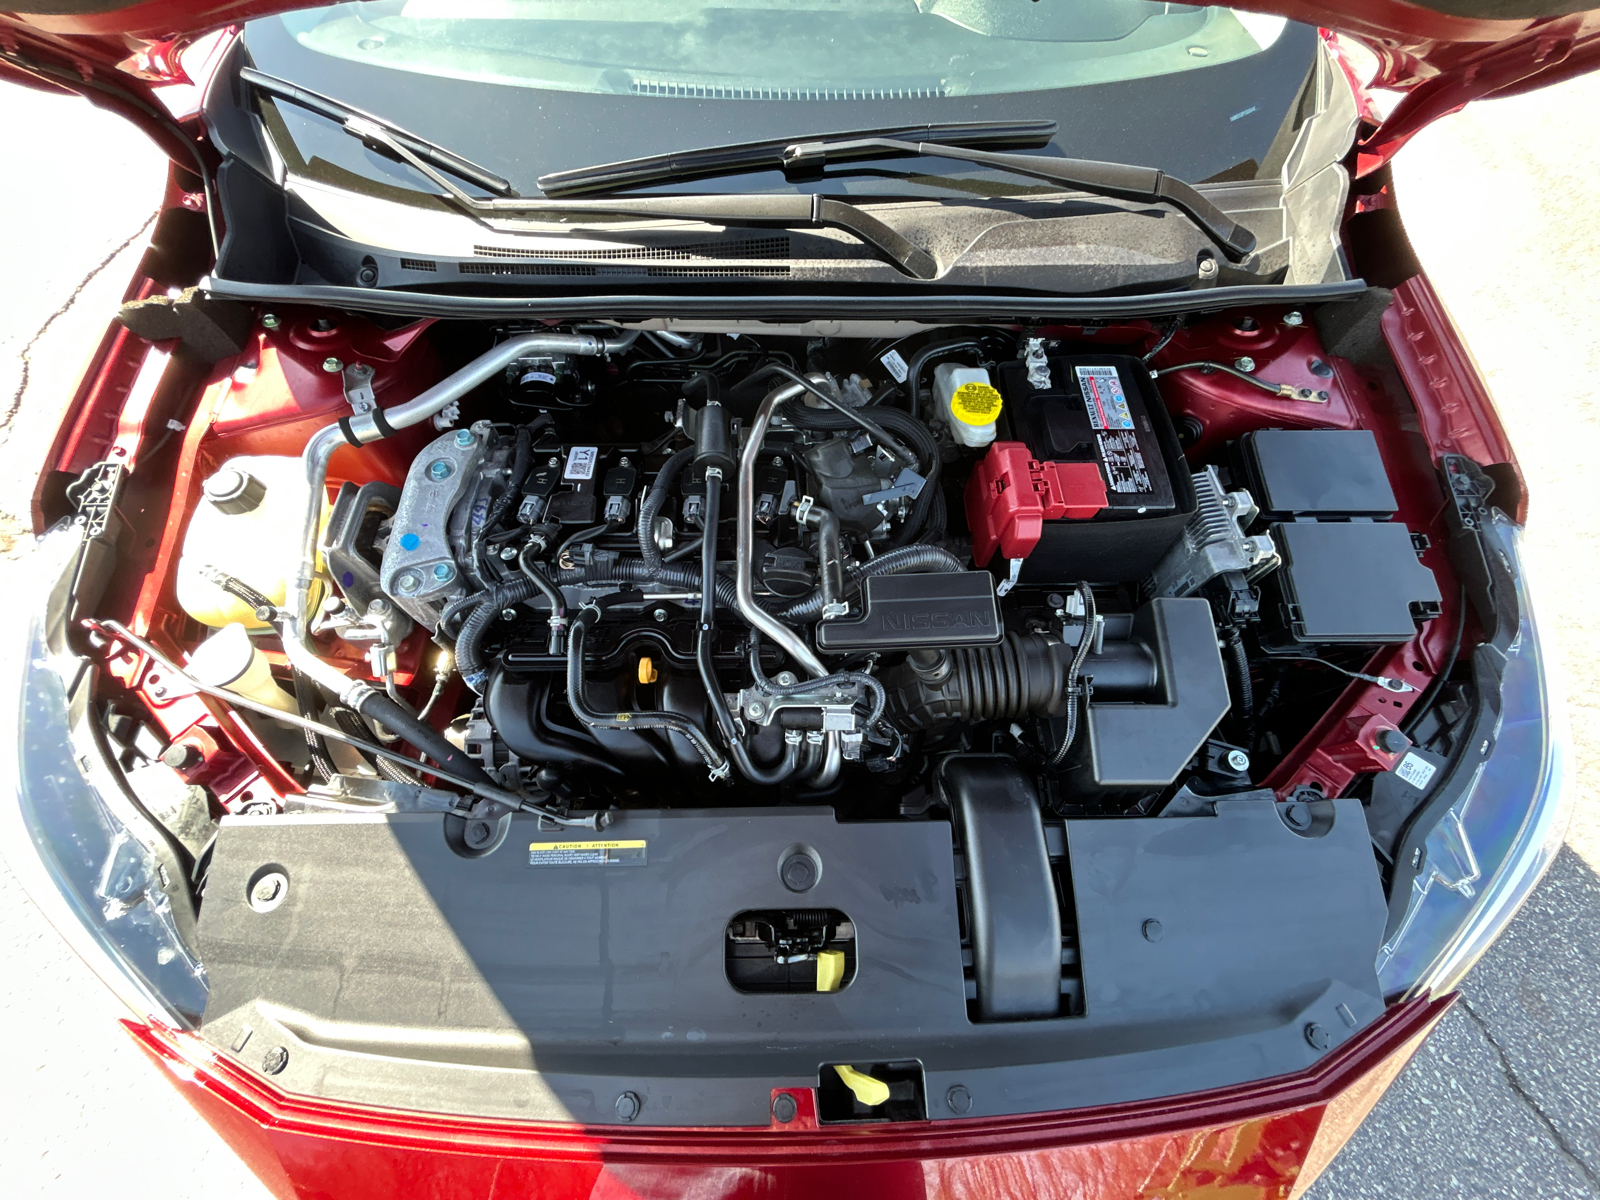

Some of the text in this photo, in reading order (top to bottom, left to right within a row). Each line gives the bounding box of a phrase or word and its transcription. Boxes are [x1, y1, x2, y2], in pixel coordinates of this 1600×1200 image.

[1080, 377, 1092, 402] NISSAN
[578, 449, 590, 460] Y1
[881, 611, 991, 631] NISSAN
